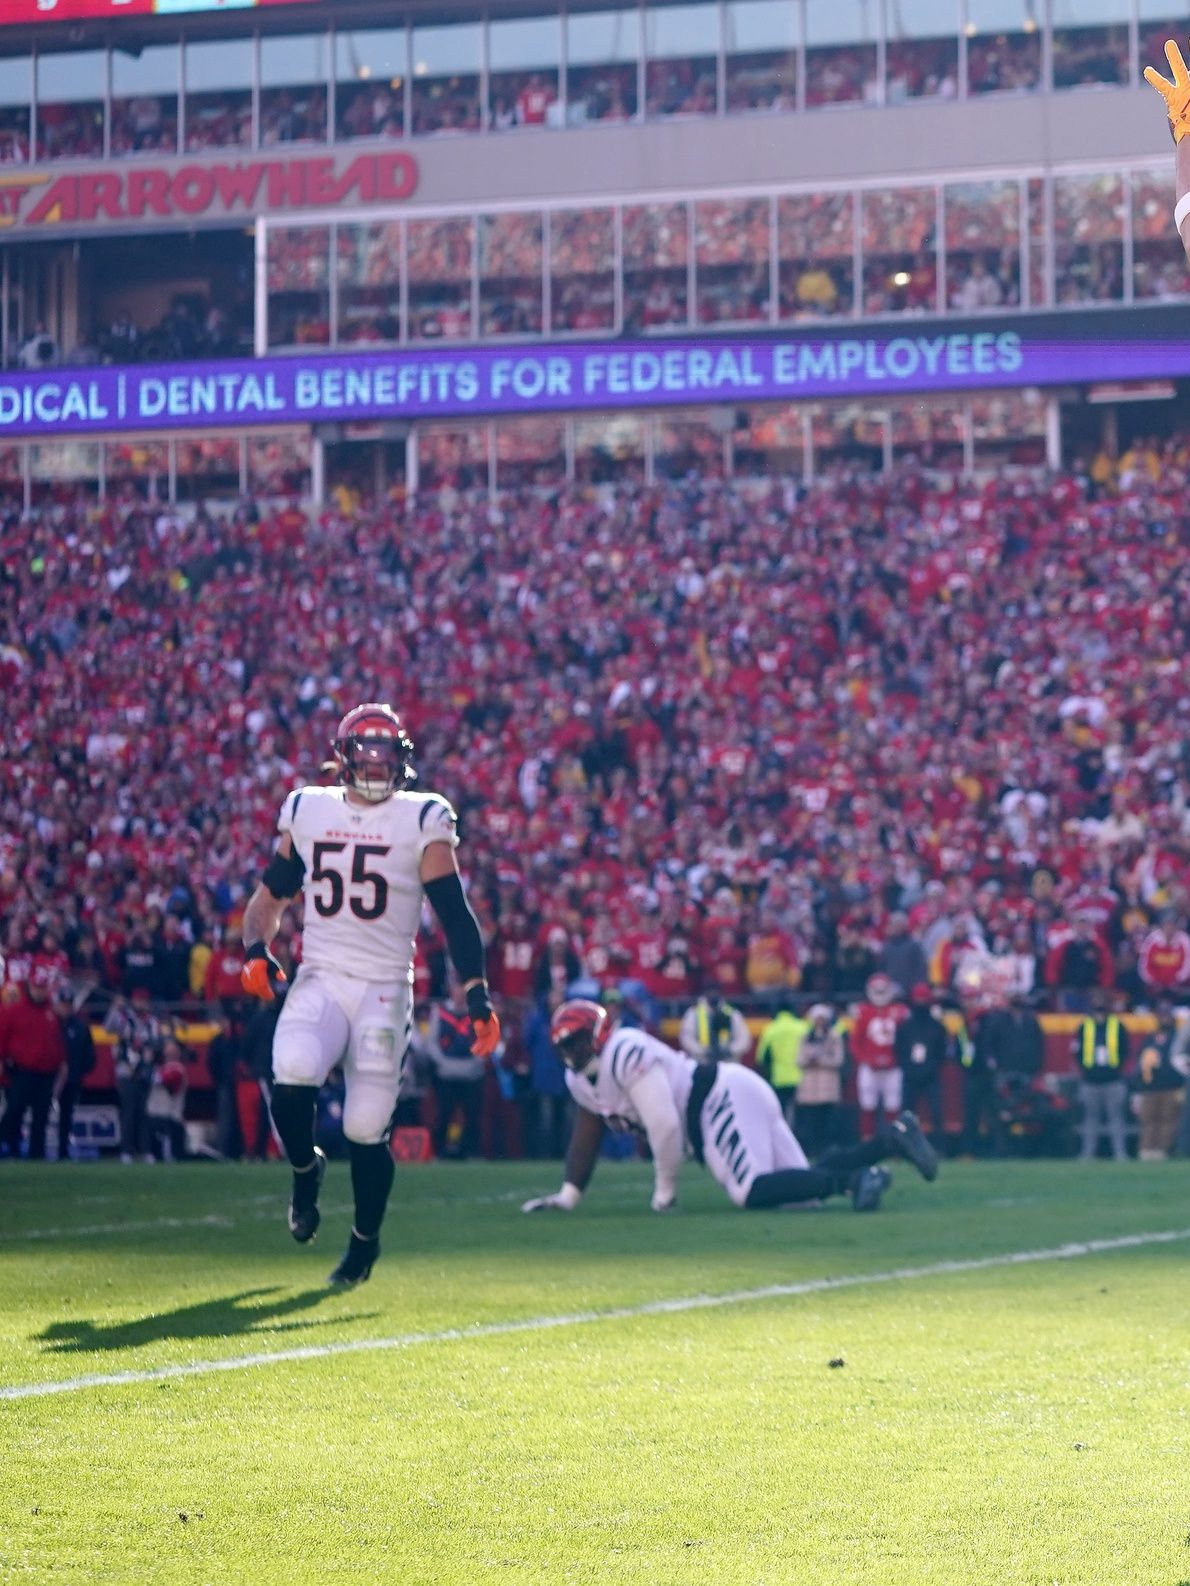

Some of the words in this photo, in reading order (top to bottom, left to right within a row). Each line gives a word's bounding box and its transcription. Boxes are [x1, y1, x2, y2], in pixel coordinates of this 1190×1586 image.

[25, 153, 418, 224] ARROWHEAD
[138, 373, 285, 417] DENTAL
[295, 360, 479, 408] BENEFITS
[490, 357, 571, 399] FOR
[584, 345, 764, 395] FEDERAL
[772, 332, 1024, 383] EMPLOYEES
[311, 841, 392, 920] 55
